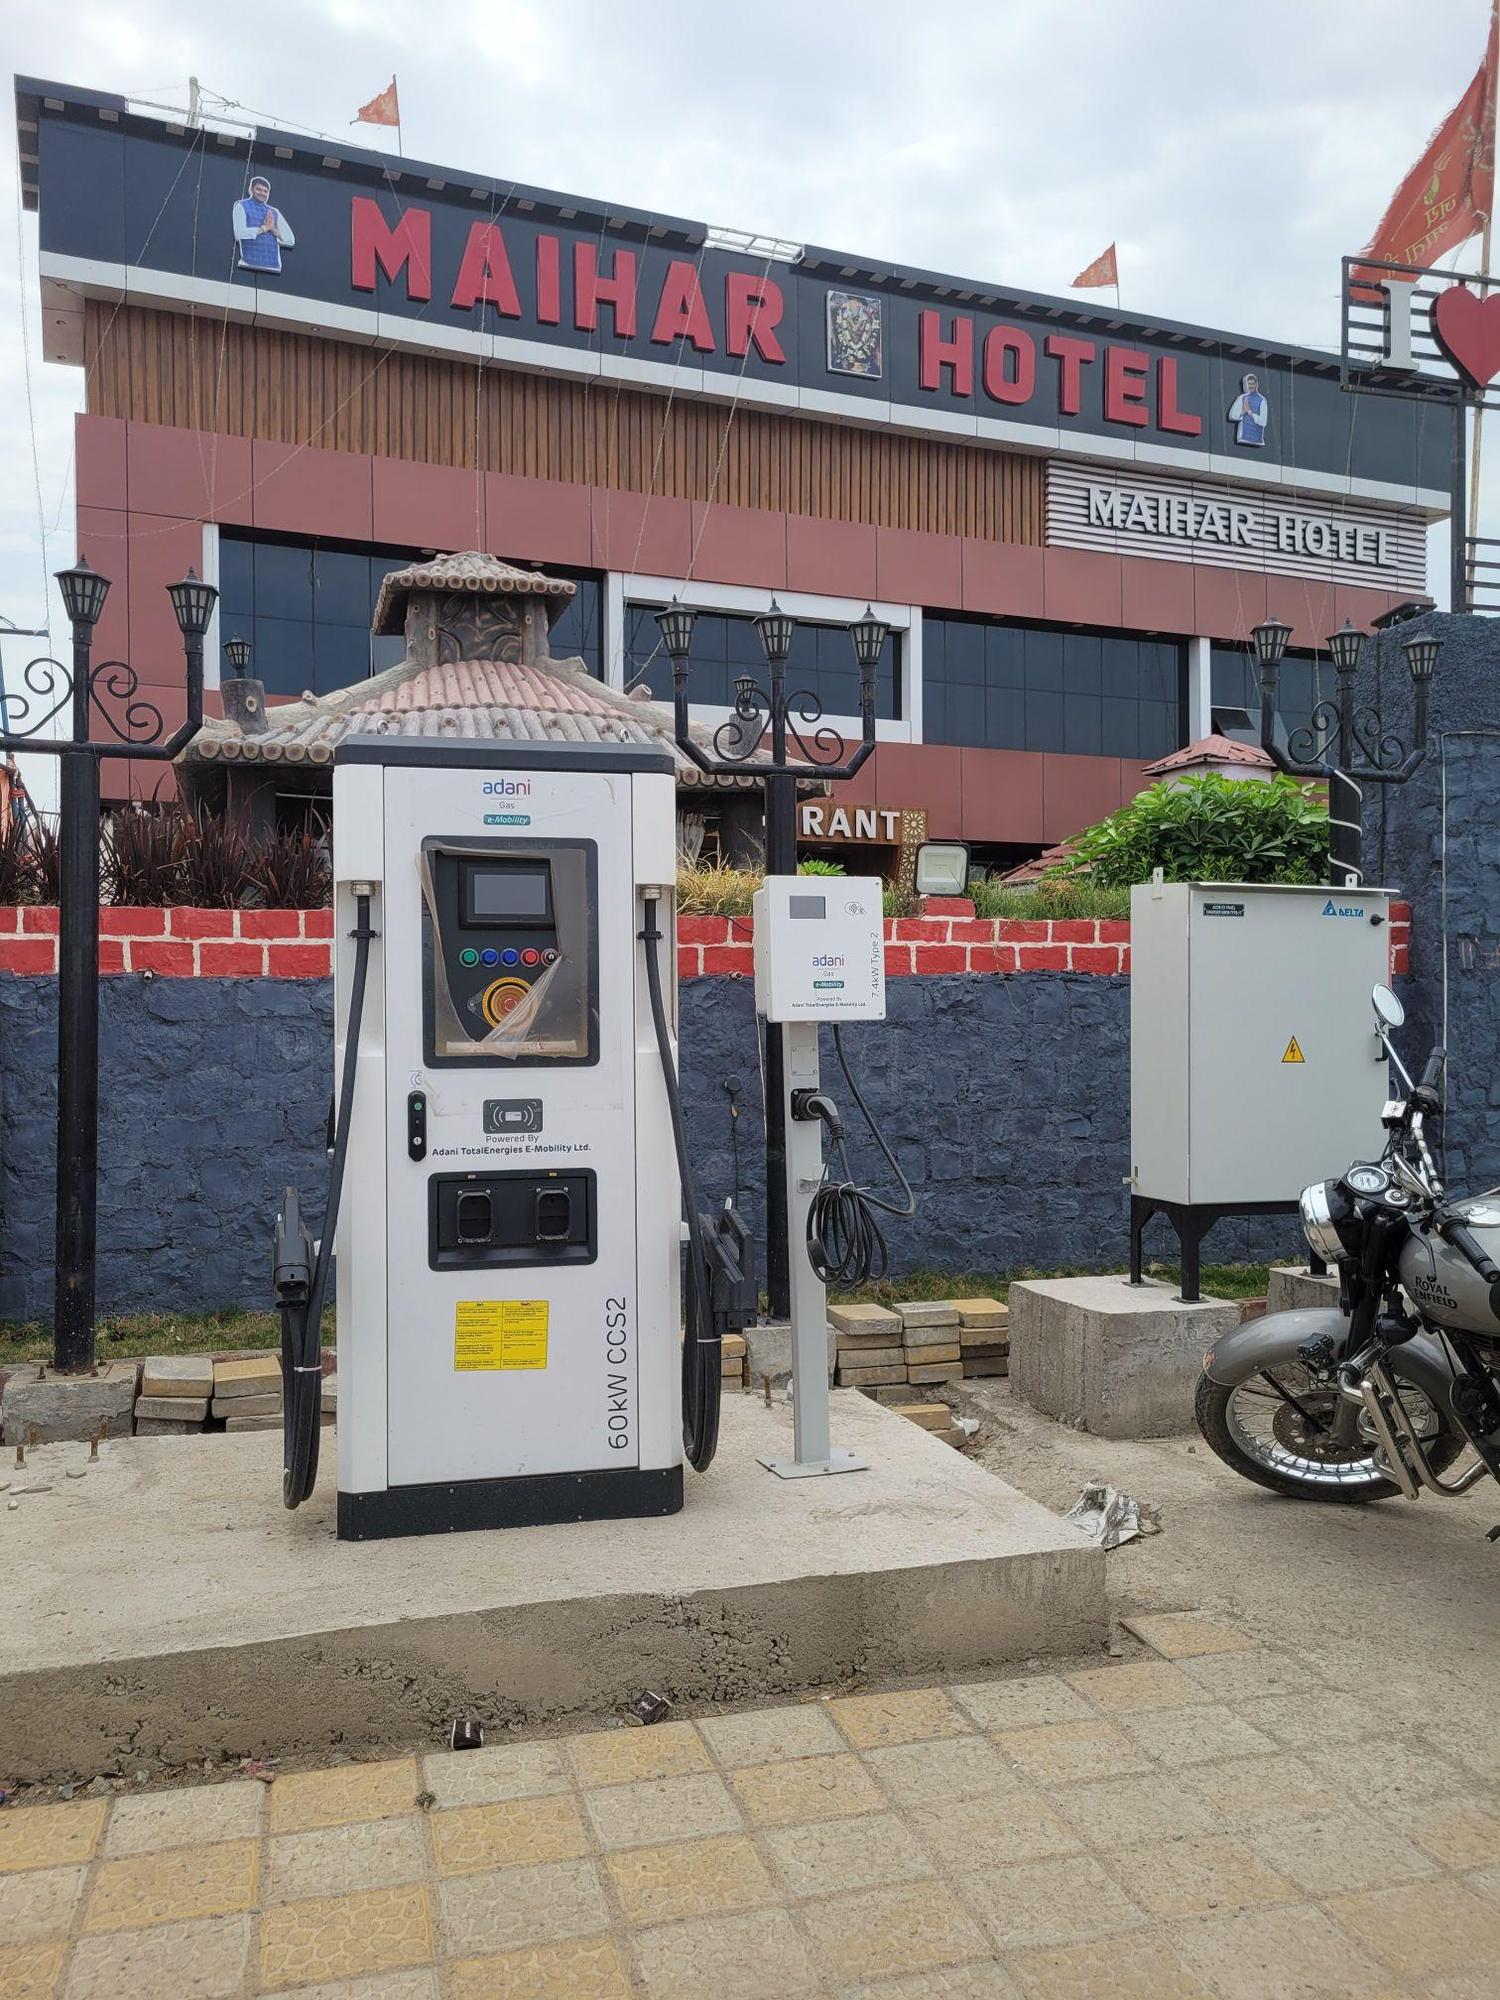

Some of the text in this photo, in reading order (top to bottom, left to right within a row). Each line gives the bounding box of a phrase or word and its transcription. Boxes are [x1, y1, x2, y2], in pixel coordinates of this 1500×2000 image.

[351, 196, 1202, 437] MAIHAR HOTEL
[1088, 486, 1398, 568] MAIHAR HOTEL
[482, 778, 531, 796] adani
[499, 800, 516, 810] Gas
[486, 815, 529, 825] e-Mobility
[1338, 907, 1364, 918] DELTA
[811, 954, 845, 967] adani
[870, 941, 881, 965] Type
[871, 967, 880, 999] 7.4kW
[485, 1134, 540, 1144] Powered By
[432, 1143, 592, 1156] Adani TotalEnergies E-Mobility Ltd.
[1415, 1275, 1450, 1297] ROYAL
[1414, 1288, 1457, 1310] ENFIELD
[605, 1297, 629, 1450] 60kW CCS2
